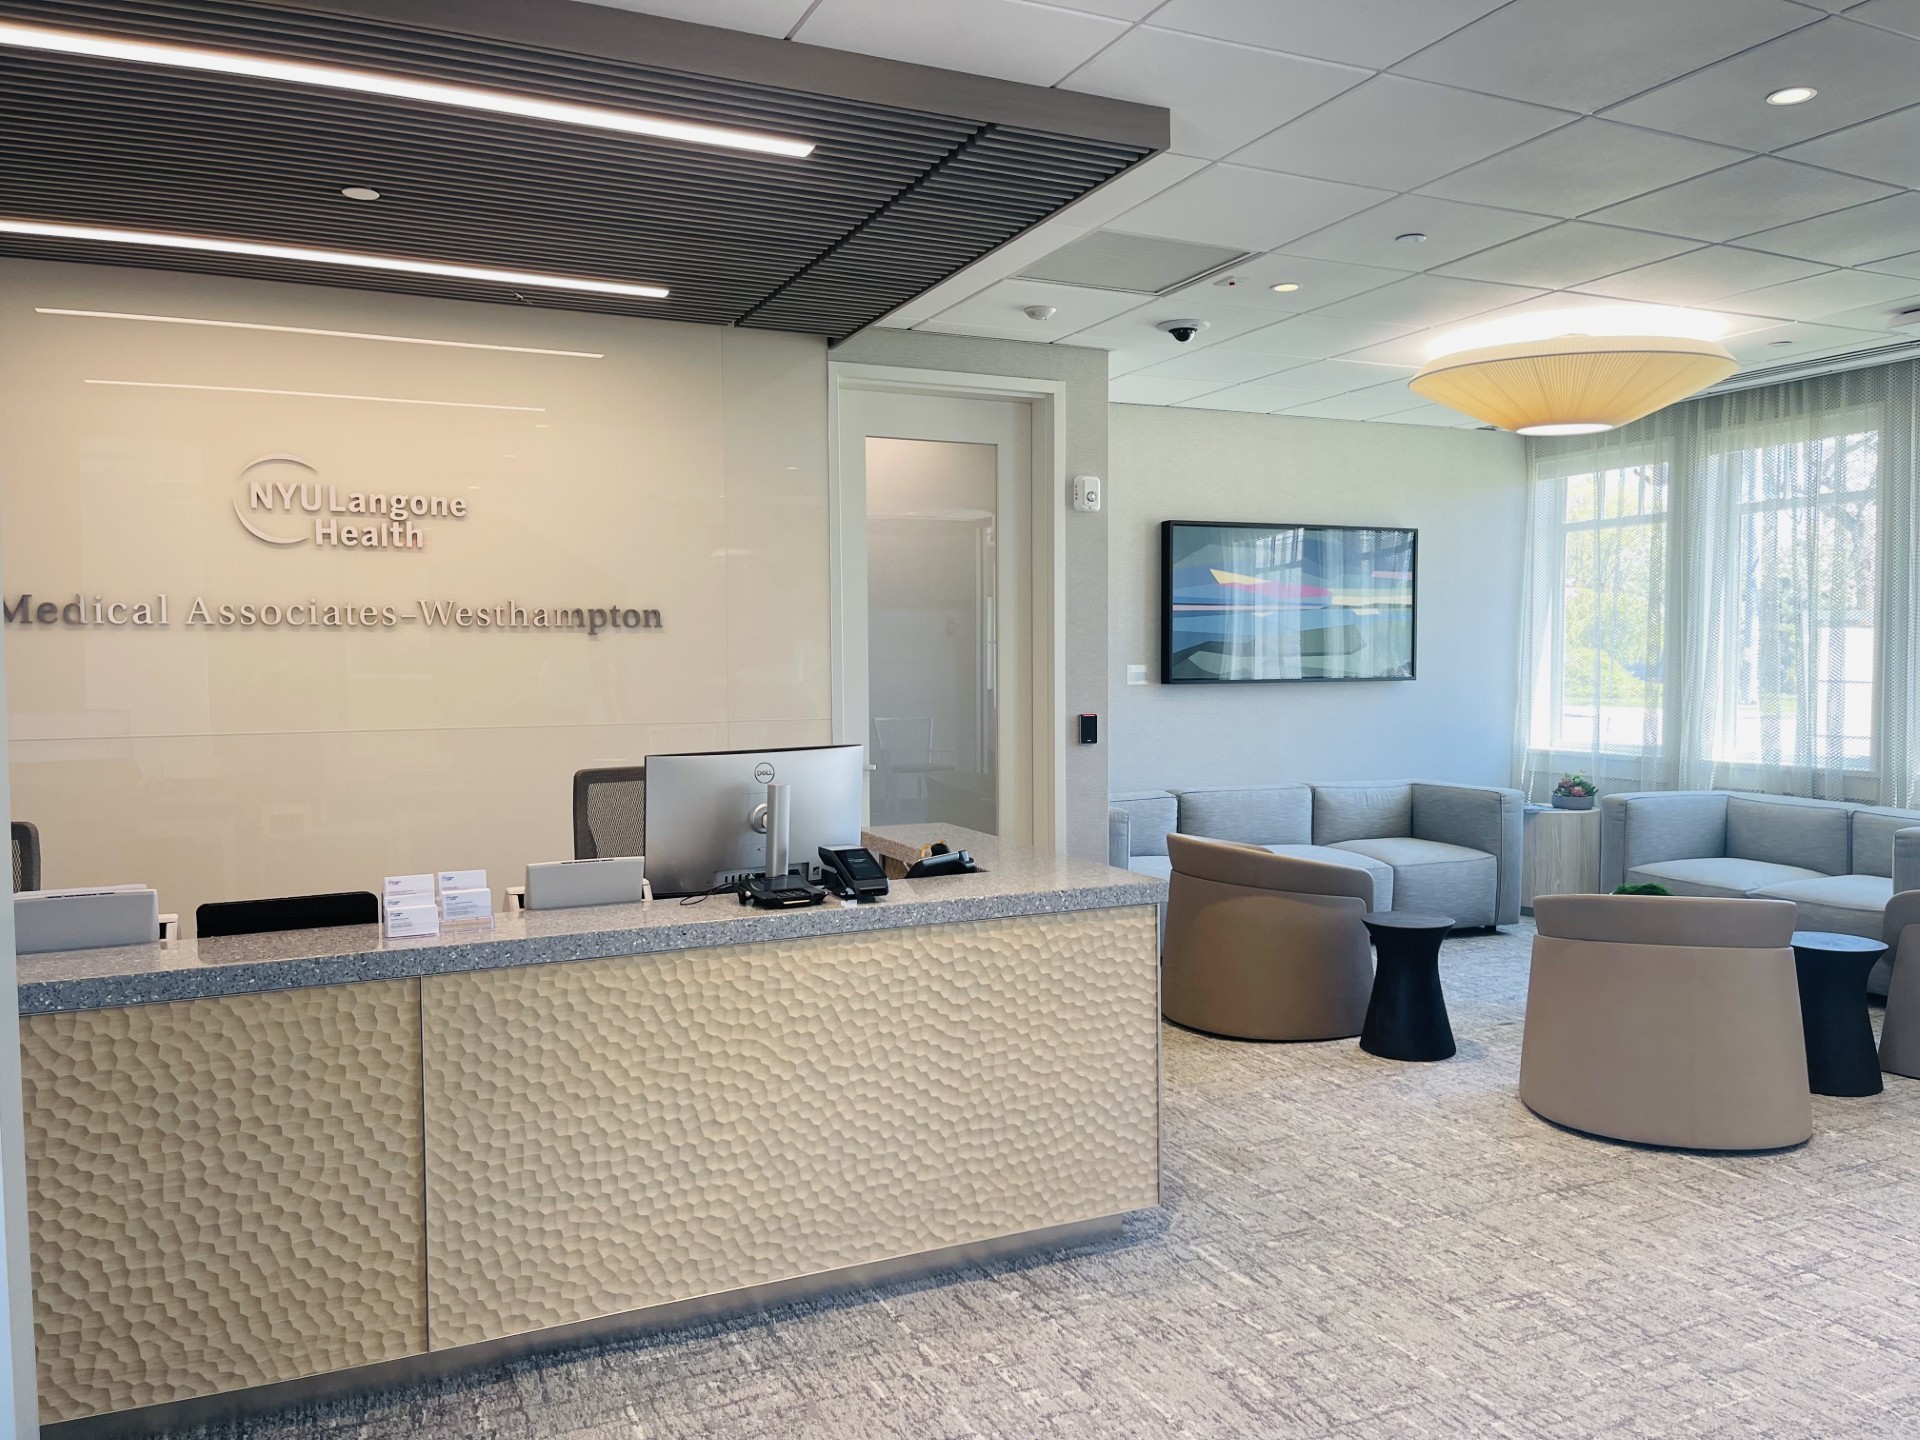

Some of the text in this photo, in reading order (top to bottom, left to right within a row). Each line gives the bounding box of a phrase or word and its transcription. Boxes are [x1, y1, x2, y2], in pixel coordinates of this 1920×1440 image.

[250, 481, 467, 520] NYU Langone
[315, 518, 423, 548] Health
[4, 594, 169, 625] Medical
